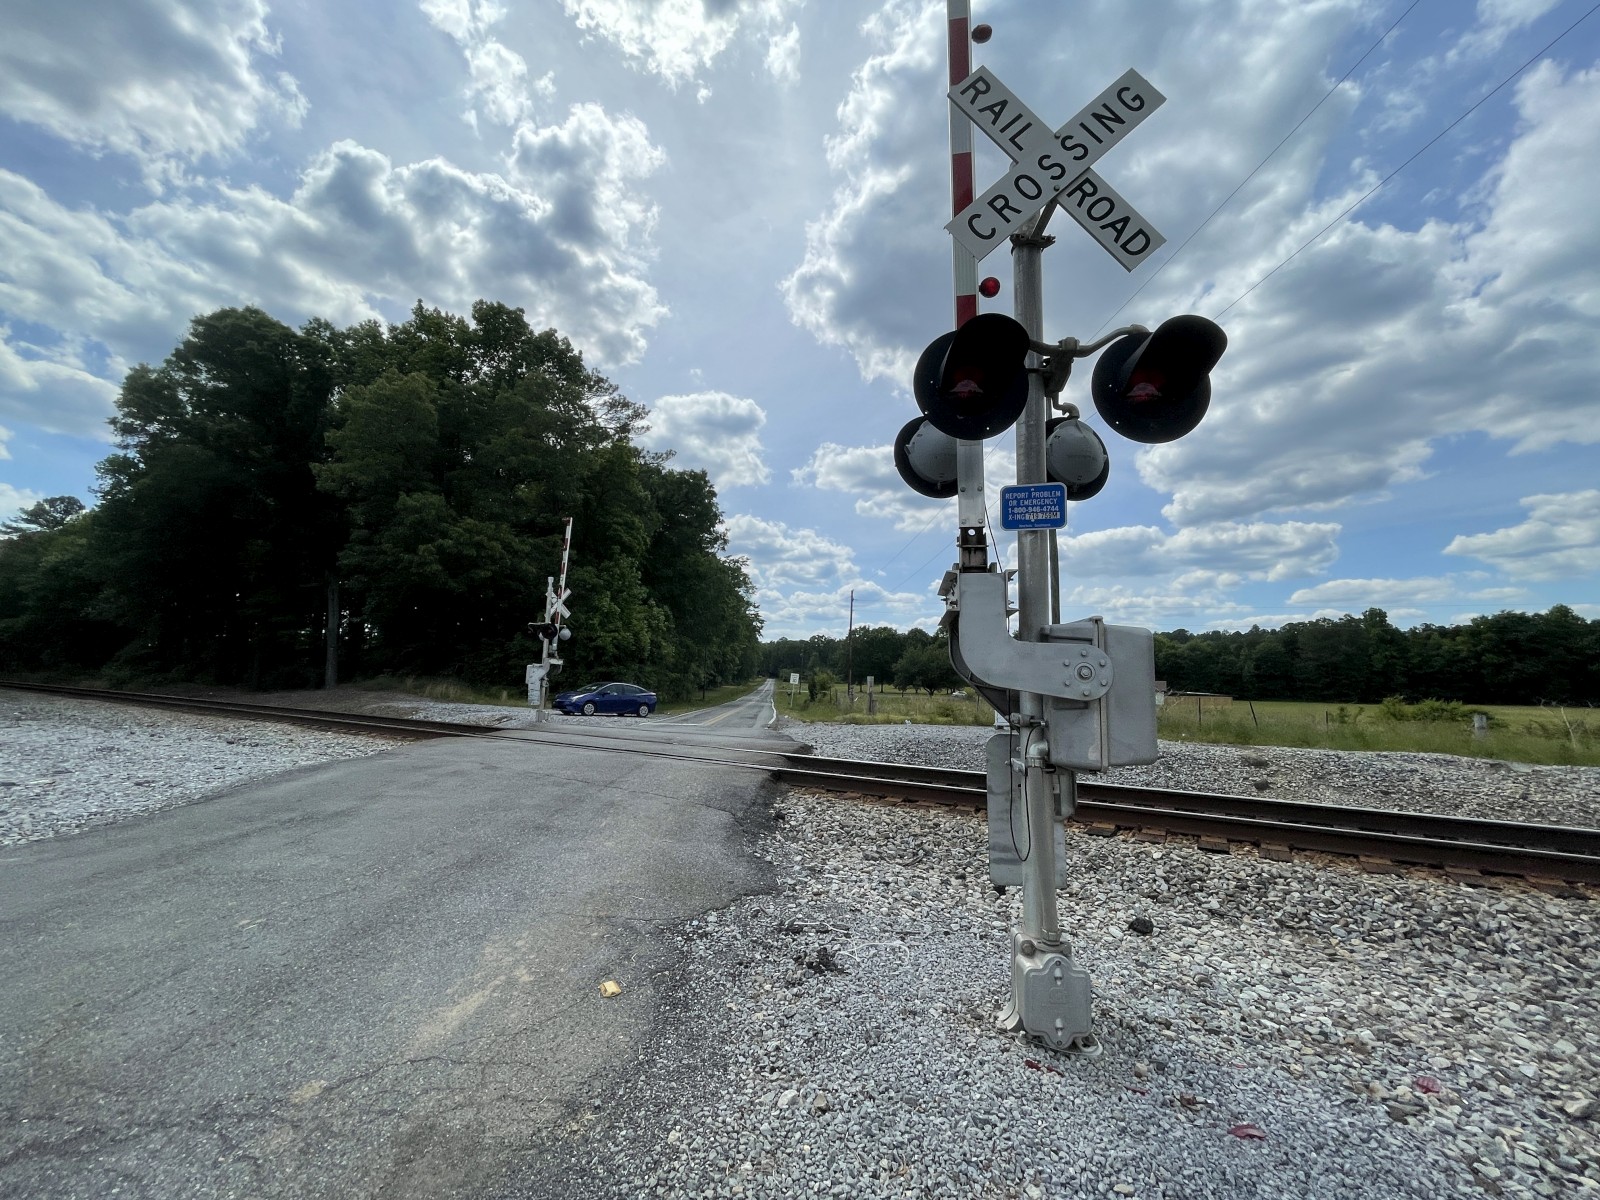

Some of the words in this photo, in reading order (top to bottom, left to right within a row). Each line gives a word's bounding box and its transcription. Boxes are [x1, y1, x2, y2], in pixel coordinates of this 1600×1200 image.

[960, 75, 1033, 152] RAIL
[1066, 177, 1151, 256] ROAD
[967, 86, 1145, 241] CROSSING
